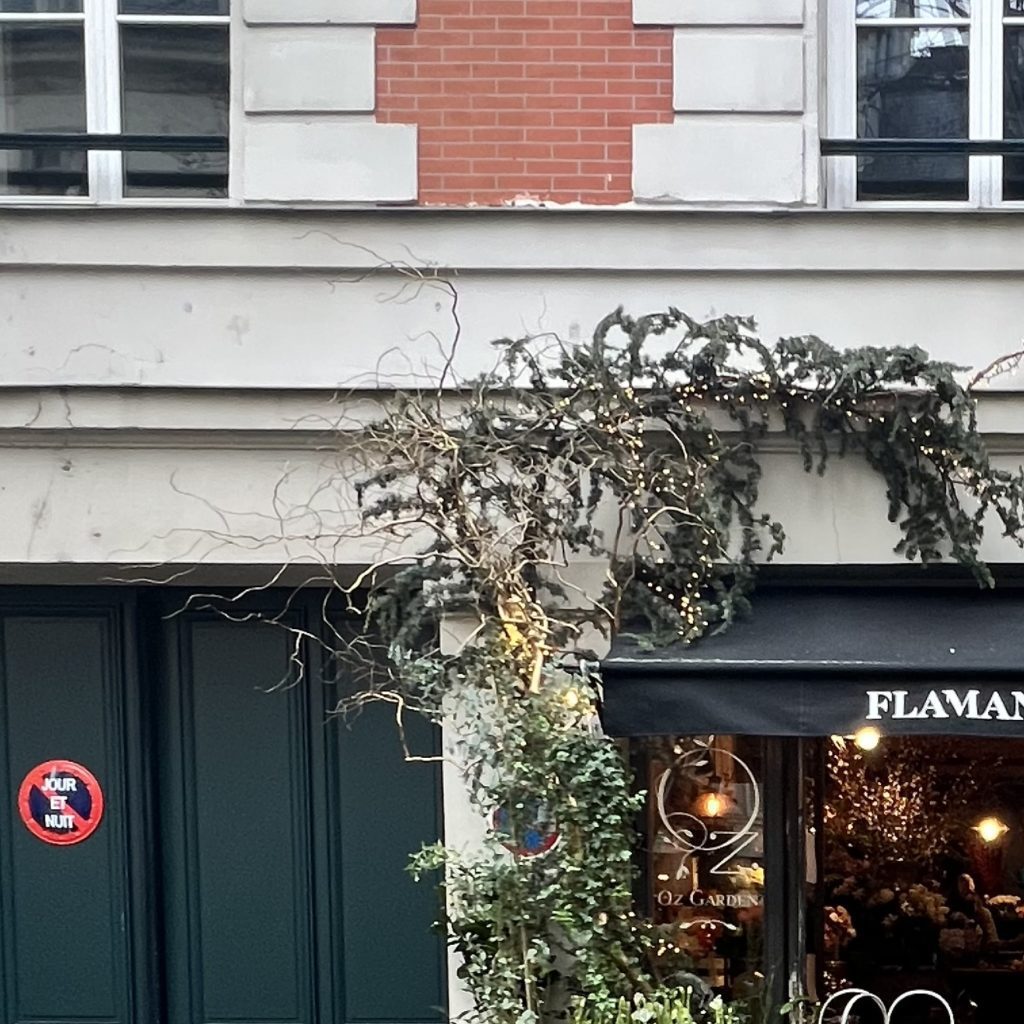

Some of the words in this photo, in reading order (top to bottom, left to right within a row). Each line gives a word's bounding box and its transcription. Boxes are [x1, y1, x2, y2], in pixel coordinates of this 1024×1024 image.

[41, 777, 77, 792] JOUR
[50, 796, 68, 810] ET
[44, 814, 75, 829] NUIT
